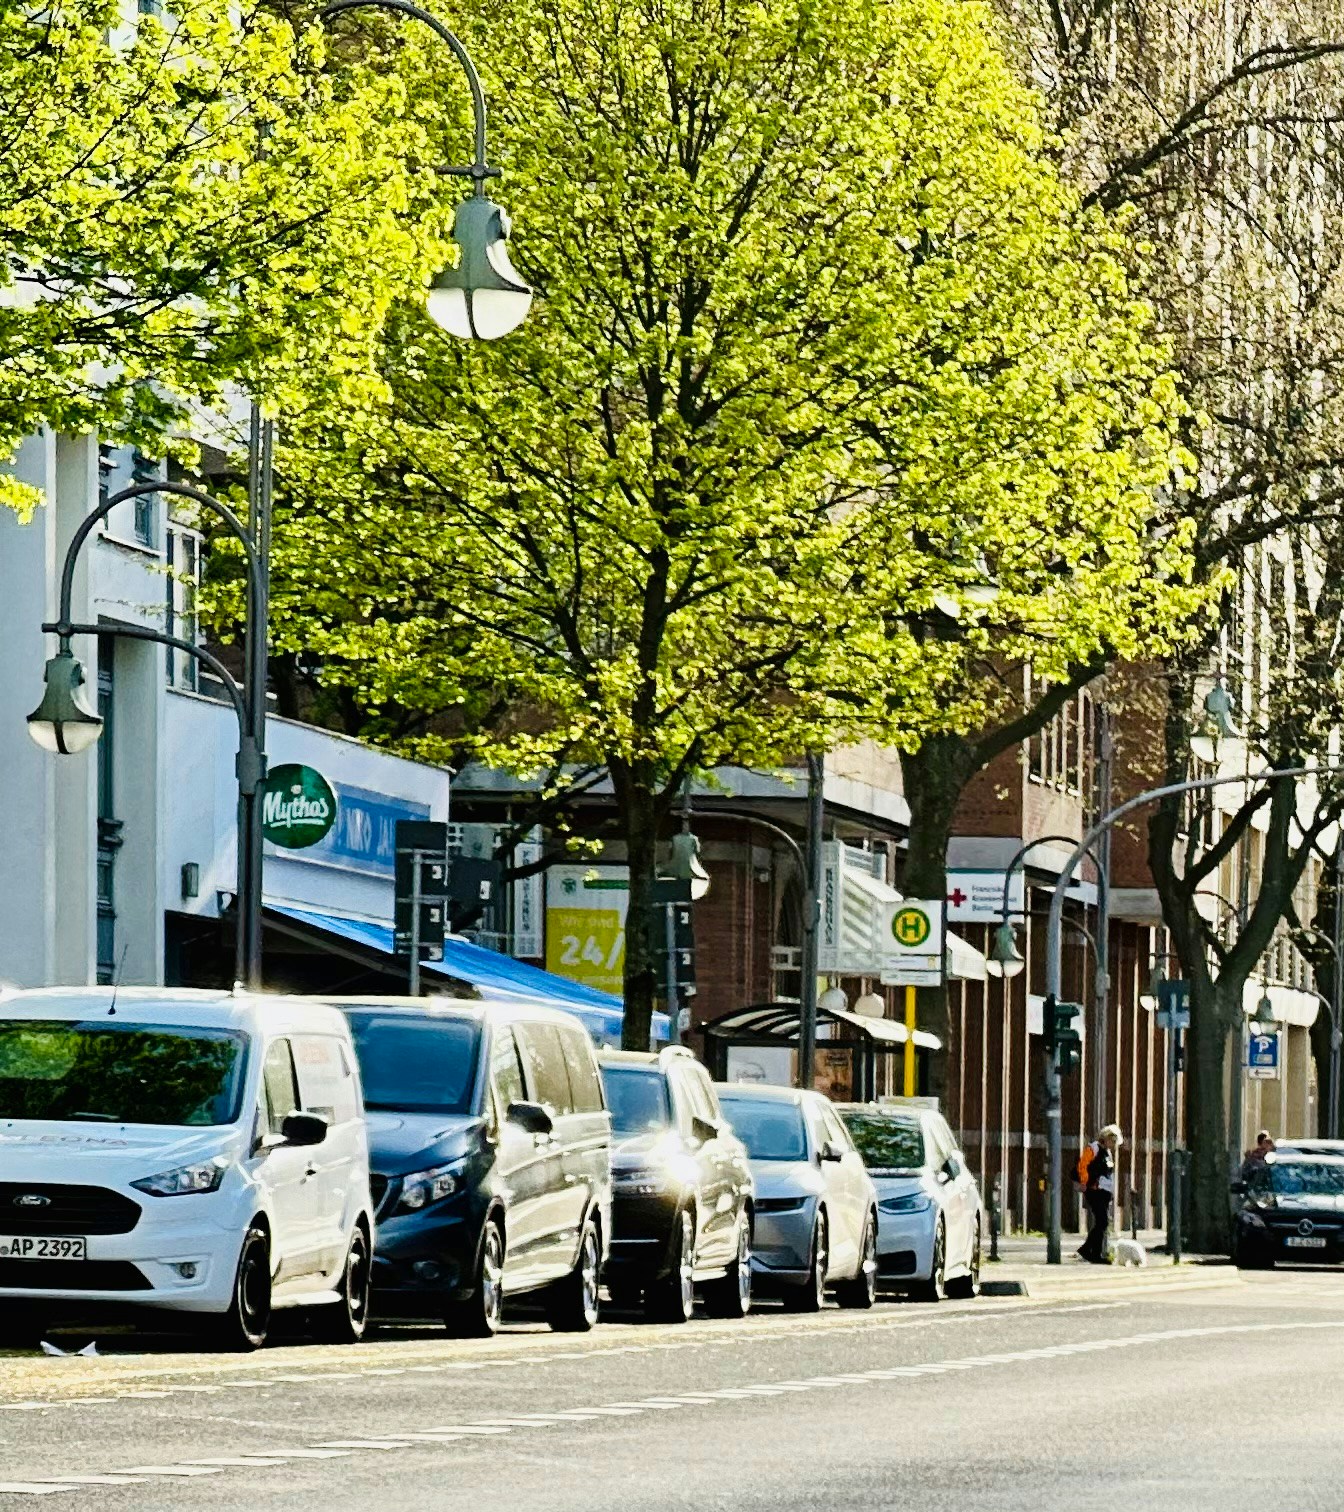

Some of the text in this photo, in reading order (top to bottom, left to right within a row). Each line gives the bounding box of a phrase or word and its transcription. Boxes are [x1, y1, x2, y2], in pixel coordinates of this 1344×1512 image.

[263, 791, 329, 828] Mythos
[901, 916, 920, 938] H
[560, 931, 626, 970] 24/
[10, 1238, 83, 1258] AP 2392
